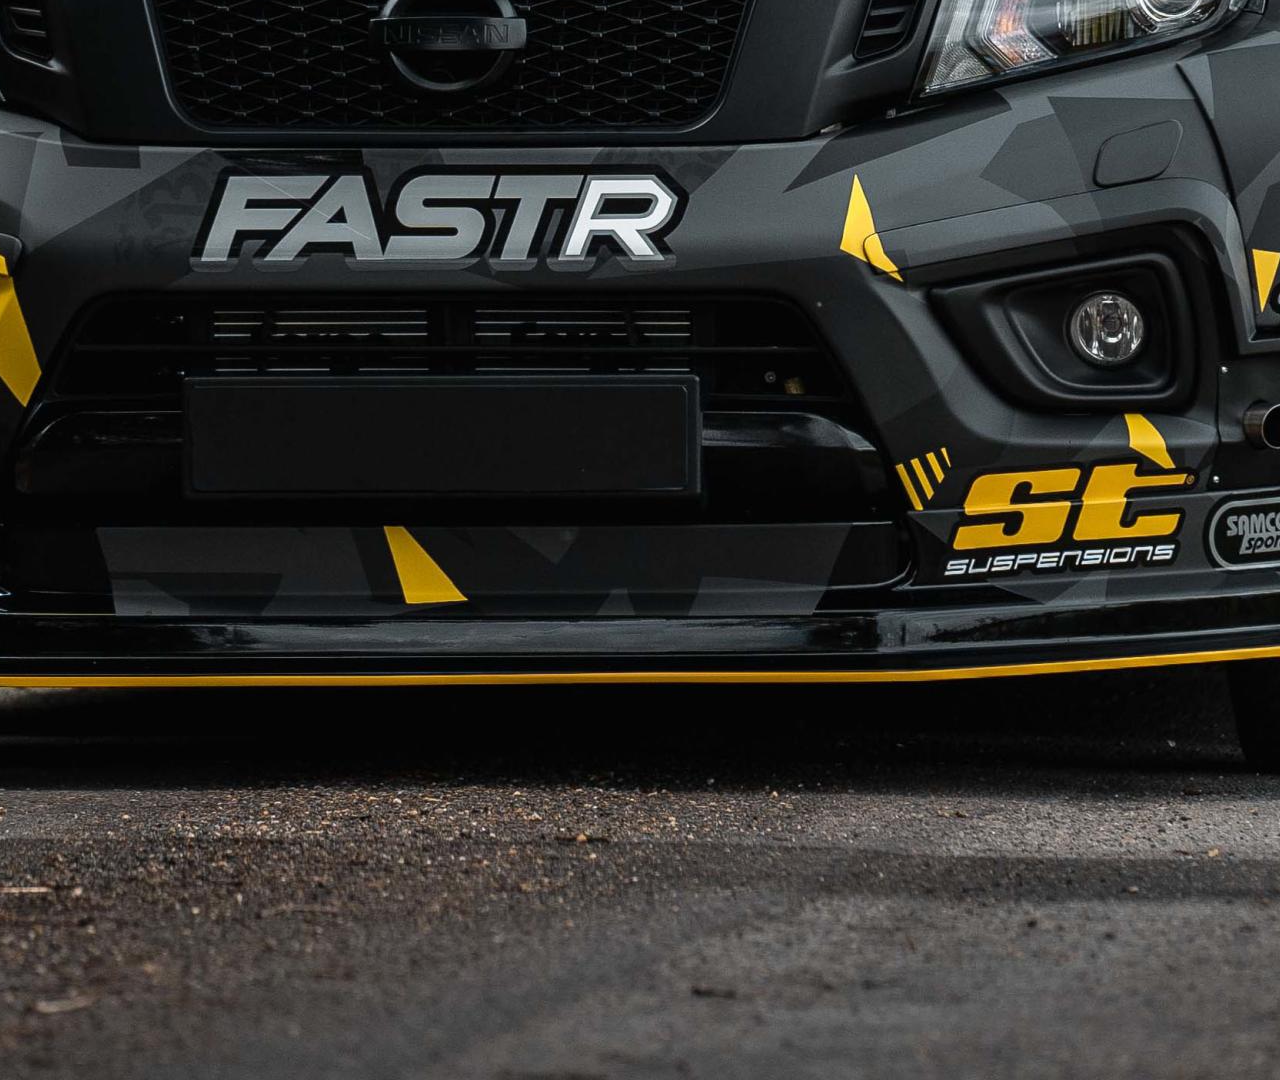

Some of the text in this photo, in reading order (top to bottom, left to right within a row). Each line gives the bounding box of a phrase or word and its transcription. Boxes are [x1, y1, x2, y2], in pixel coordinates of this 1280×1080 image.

[383, 23, 509, 44] NISSAN
[200, 174, 676, 262] FASTR
[945, 544, 1176, 577] SUSPENSIONS
